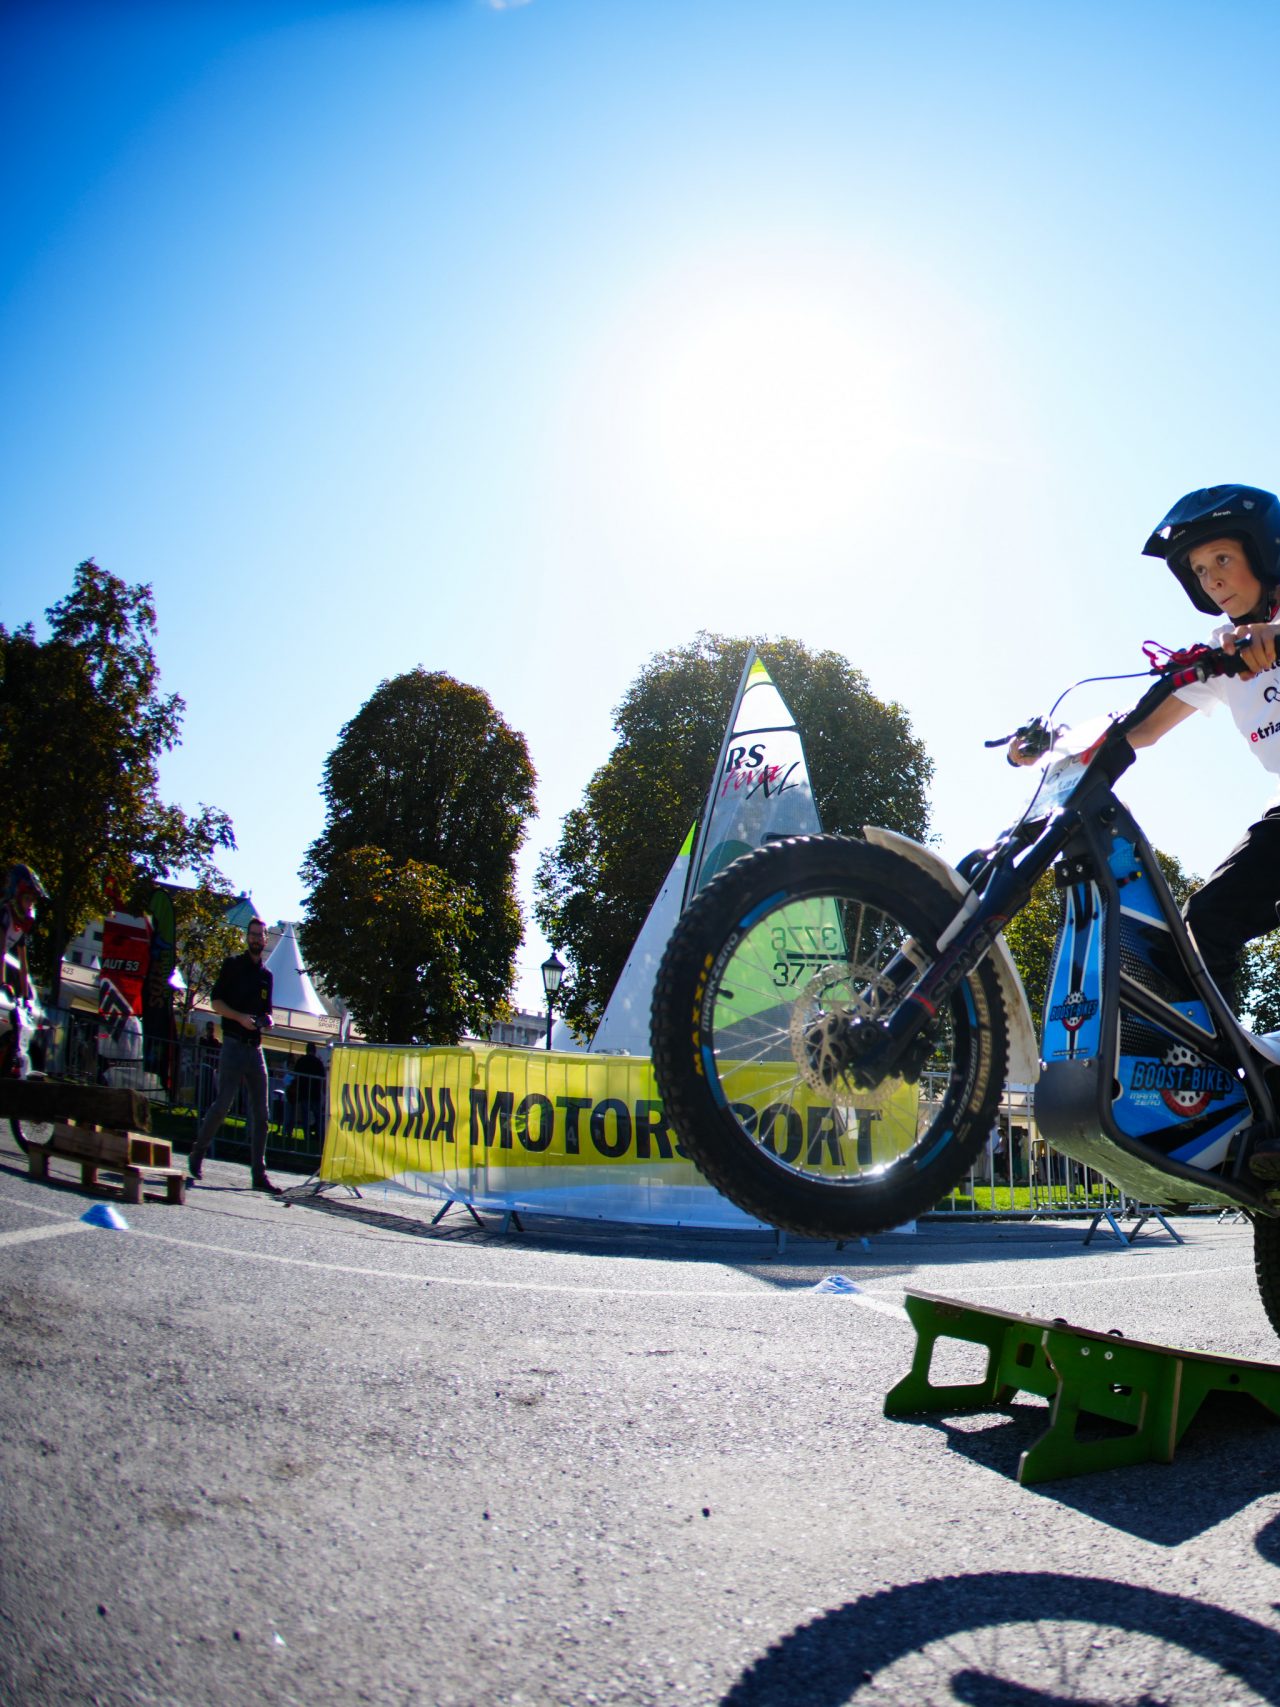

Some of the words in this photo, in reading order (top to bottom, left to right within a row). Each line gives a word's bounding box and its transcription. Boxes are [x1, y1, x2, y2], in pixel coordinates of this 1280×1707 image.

[725, 743, 767, 774] RS
[103, 958, 124, 969] AUT
[773, 962, 836, 987] 377
[340, 1083, 456, 1143] AUSTRIA
[469, 1088, 883, 1167] MOTORORT
